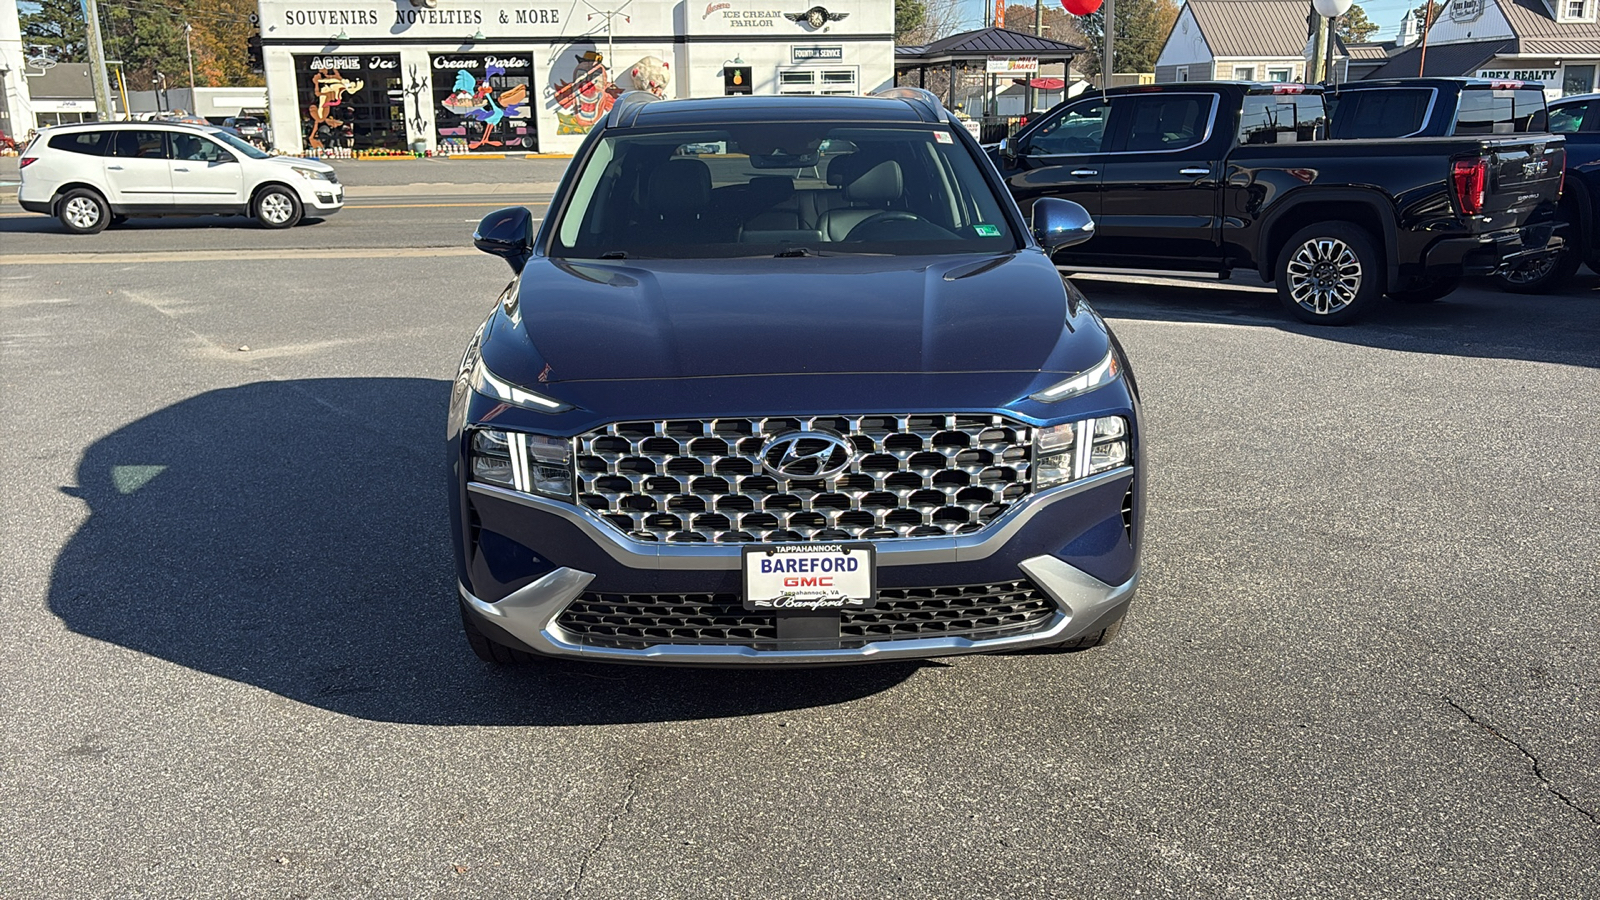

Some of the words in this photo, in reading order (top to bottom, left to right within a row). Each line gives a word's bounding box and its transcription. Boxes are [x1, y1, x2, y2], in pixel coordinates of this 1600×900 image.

[285, 10, 378, 25] SOUVENIRS
[395, 9, 482, 24] NOVELTIES
[499, 9, 509, 24] &
[515, 9, 559, 24] MORE
[722, 10, 740, 18] ICE
[742, 10, 781, 18] CREAM
[730, 19, 774, 27] PARLOR
[820, 49, 841, 57] SERVICE
[310, 56, 361, 70] ACME
[368, 55, 398, 70] Ice
[433, 55, 479, 69] Cream
[484, 55, 530, 69] Parlor
[1513, 70, 1557, 81] REALTY
[776, 545, 842, 553] TAPPAHANNOCK
[761, 557, 858, 573] BAREFORD
[784, 577, 833, 587] GMC
[773, 595, 846, 611] Bareford
